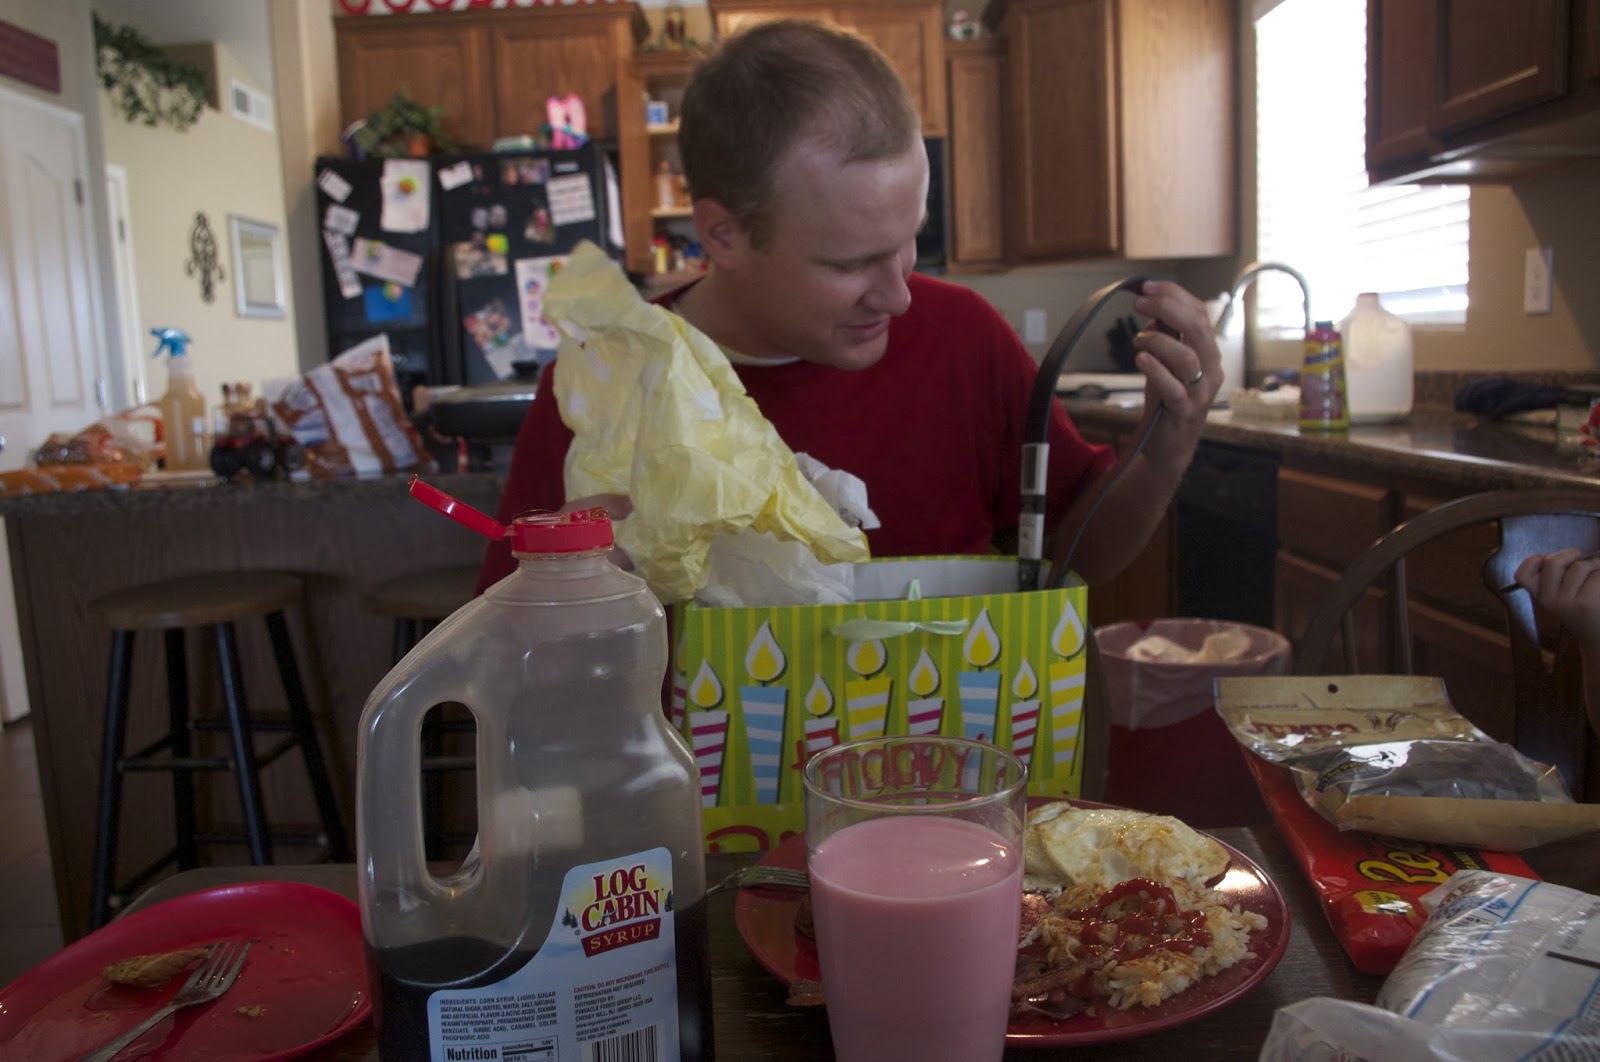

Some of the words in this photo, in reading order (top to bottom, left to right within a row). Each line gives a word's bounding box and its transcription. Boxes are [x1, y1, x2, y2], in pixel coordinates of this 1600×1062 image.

[593, 865, 647, 902] LOG
[582, 890, 659, 932] CABIN
[590, 924, 654, 950] SYRUP
[616, 972, 643, 984] MICROWAVE
[575, 988, 611, 1000] REFRIGERATION
[623, 978, 645, 989] REQUIRED
[575, 997, 606, 1008] DISTRIBUTED
[575, 1005, 598, 1015] PINNACLE
[447, 1048, 497, 1061] Nutrition
